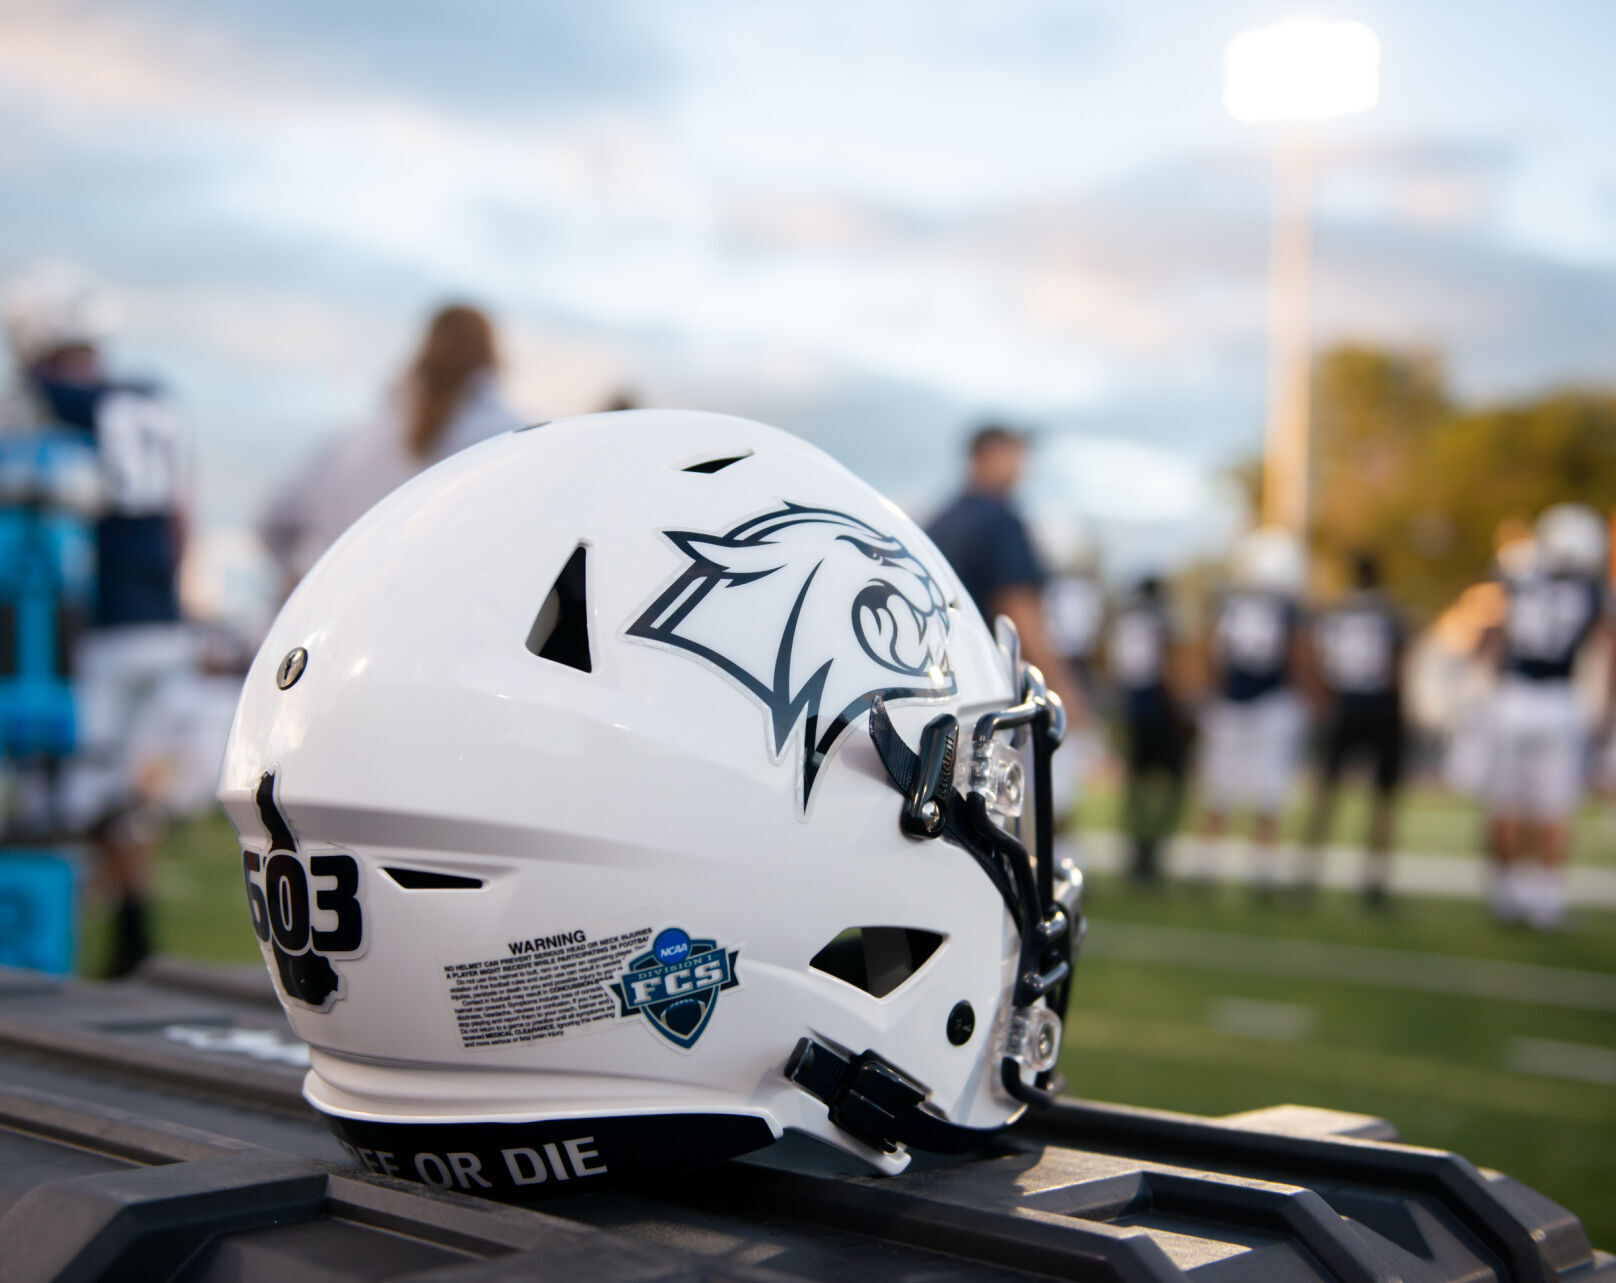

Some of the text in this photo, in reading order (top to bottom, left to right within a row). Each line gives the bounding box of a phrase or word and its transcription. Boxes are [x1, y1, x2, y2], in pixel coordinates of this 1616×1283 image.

[455, 962, 482, 970] HELMET
[500, 955, 531, 964] PREVENT
[534, 949, 564, 959] SERIOUS
[566, 944, 586, 953] HEAD
[599, 936, 618, 945] NECK
[621, 927, 652, 940] INJURIES
[508, 930, 586, 955] WARNING
[660, 943, 688, 958] NCAA
[452, 970, 478, 978] PLAYER
[479, 967, 500, 975] MIGHT
[502, 962, 532, 971] RECEIVE
[534, 958, 555, 966] WHILE
[557, 947, 608, 961] PARTICIPATING
[638, 958, 702, 979] DIVISION
[631, 960, 724, 1005] FCS
[485, 1030, 512, 1038] MEDICAL
[414, 1152, 492, 1188] OR
[501, 1136, 608, 1186] DIE
